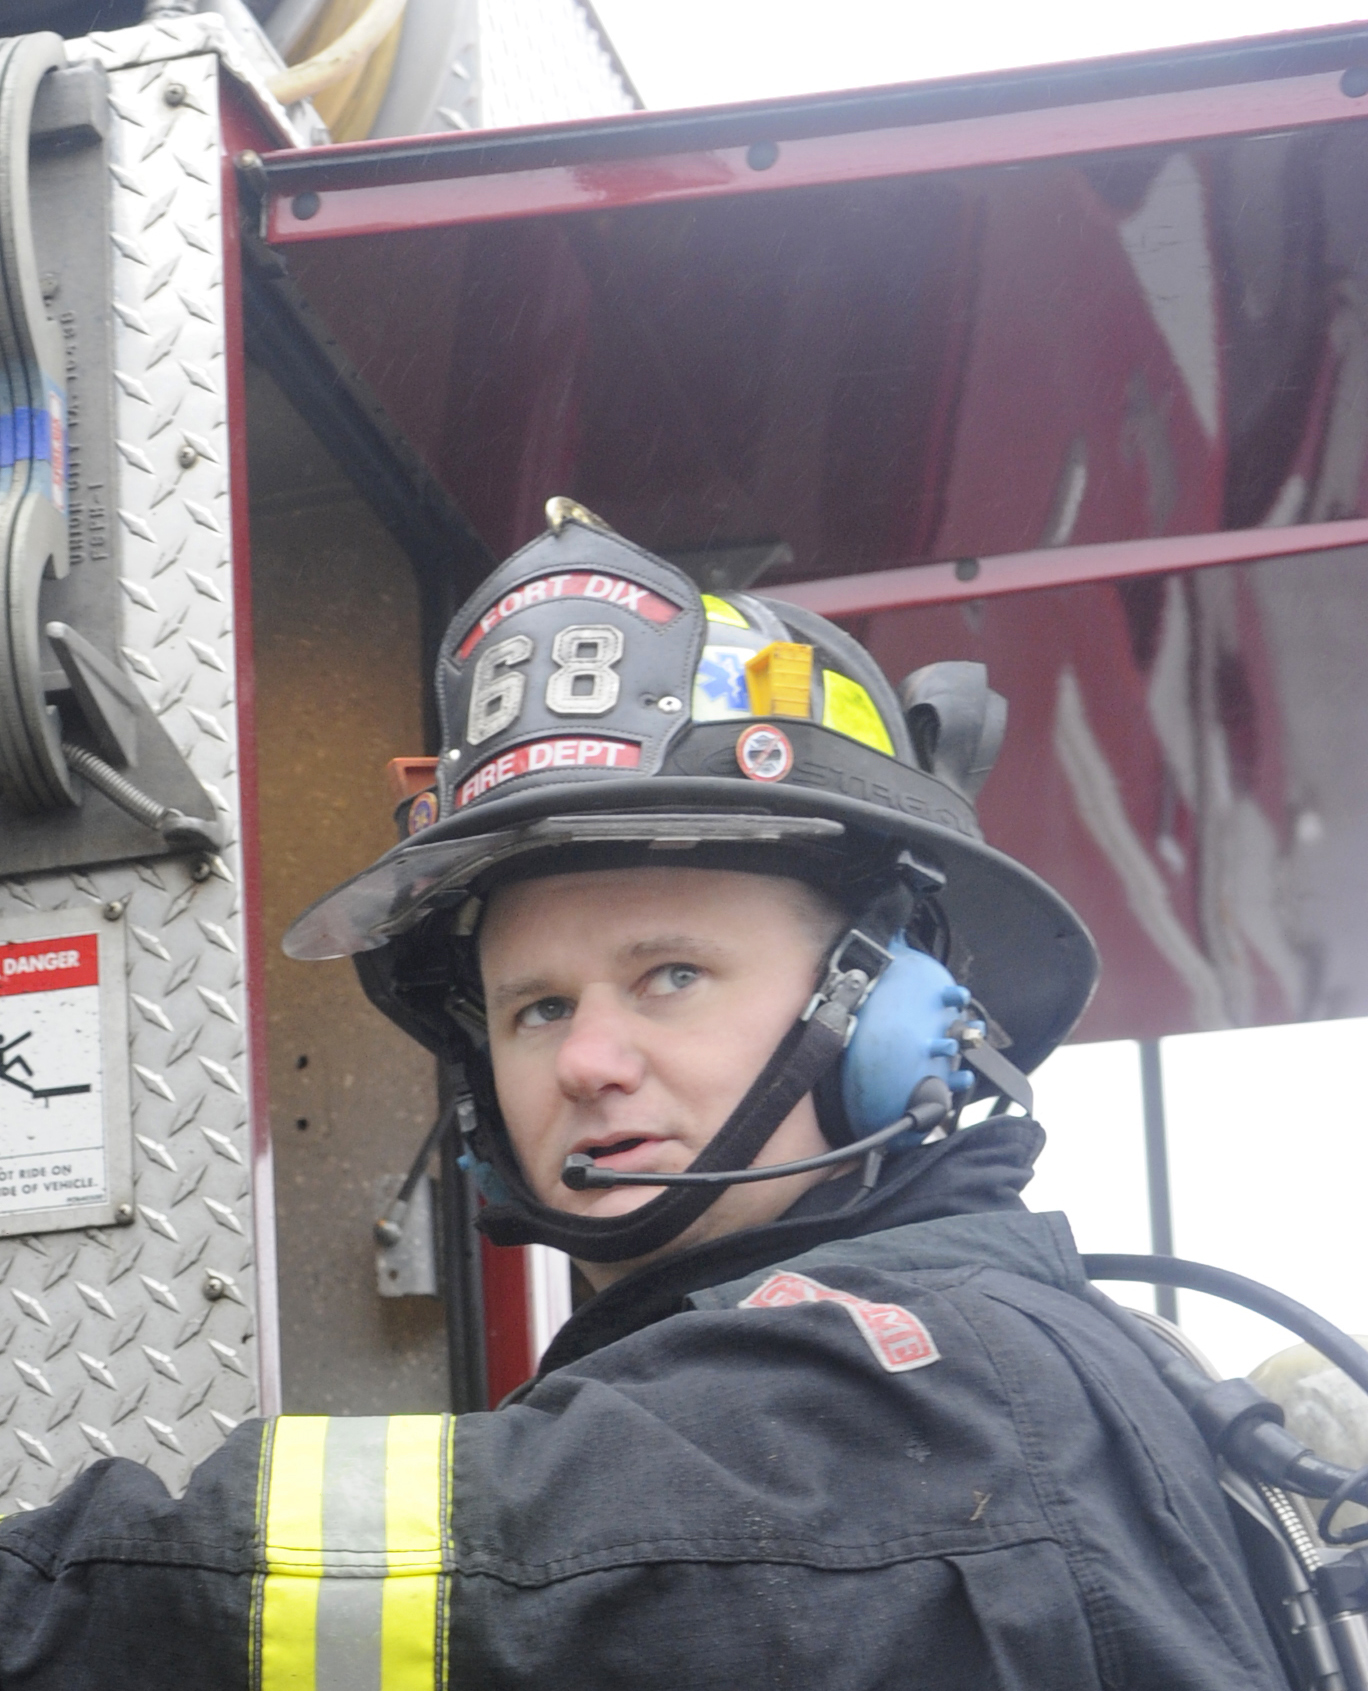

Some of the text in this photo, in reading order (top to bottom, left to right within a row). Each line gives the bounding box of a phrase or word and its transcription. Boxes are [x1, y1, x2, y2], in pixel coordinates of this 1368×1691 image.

[480, 574, 650, 633] FORT DIX
[466, 623, 624, 746] 68
[461, 739, 627, 807] FIRE DEPT
[3, 950, 81, 976] DANGER
[19, 1167, 47, 1180] RIDE
[51, 1164, 72, 1176] ON
[22, 1183, 38, 1195] OF
